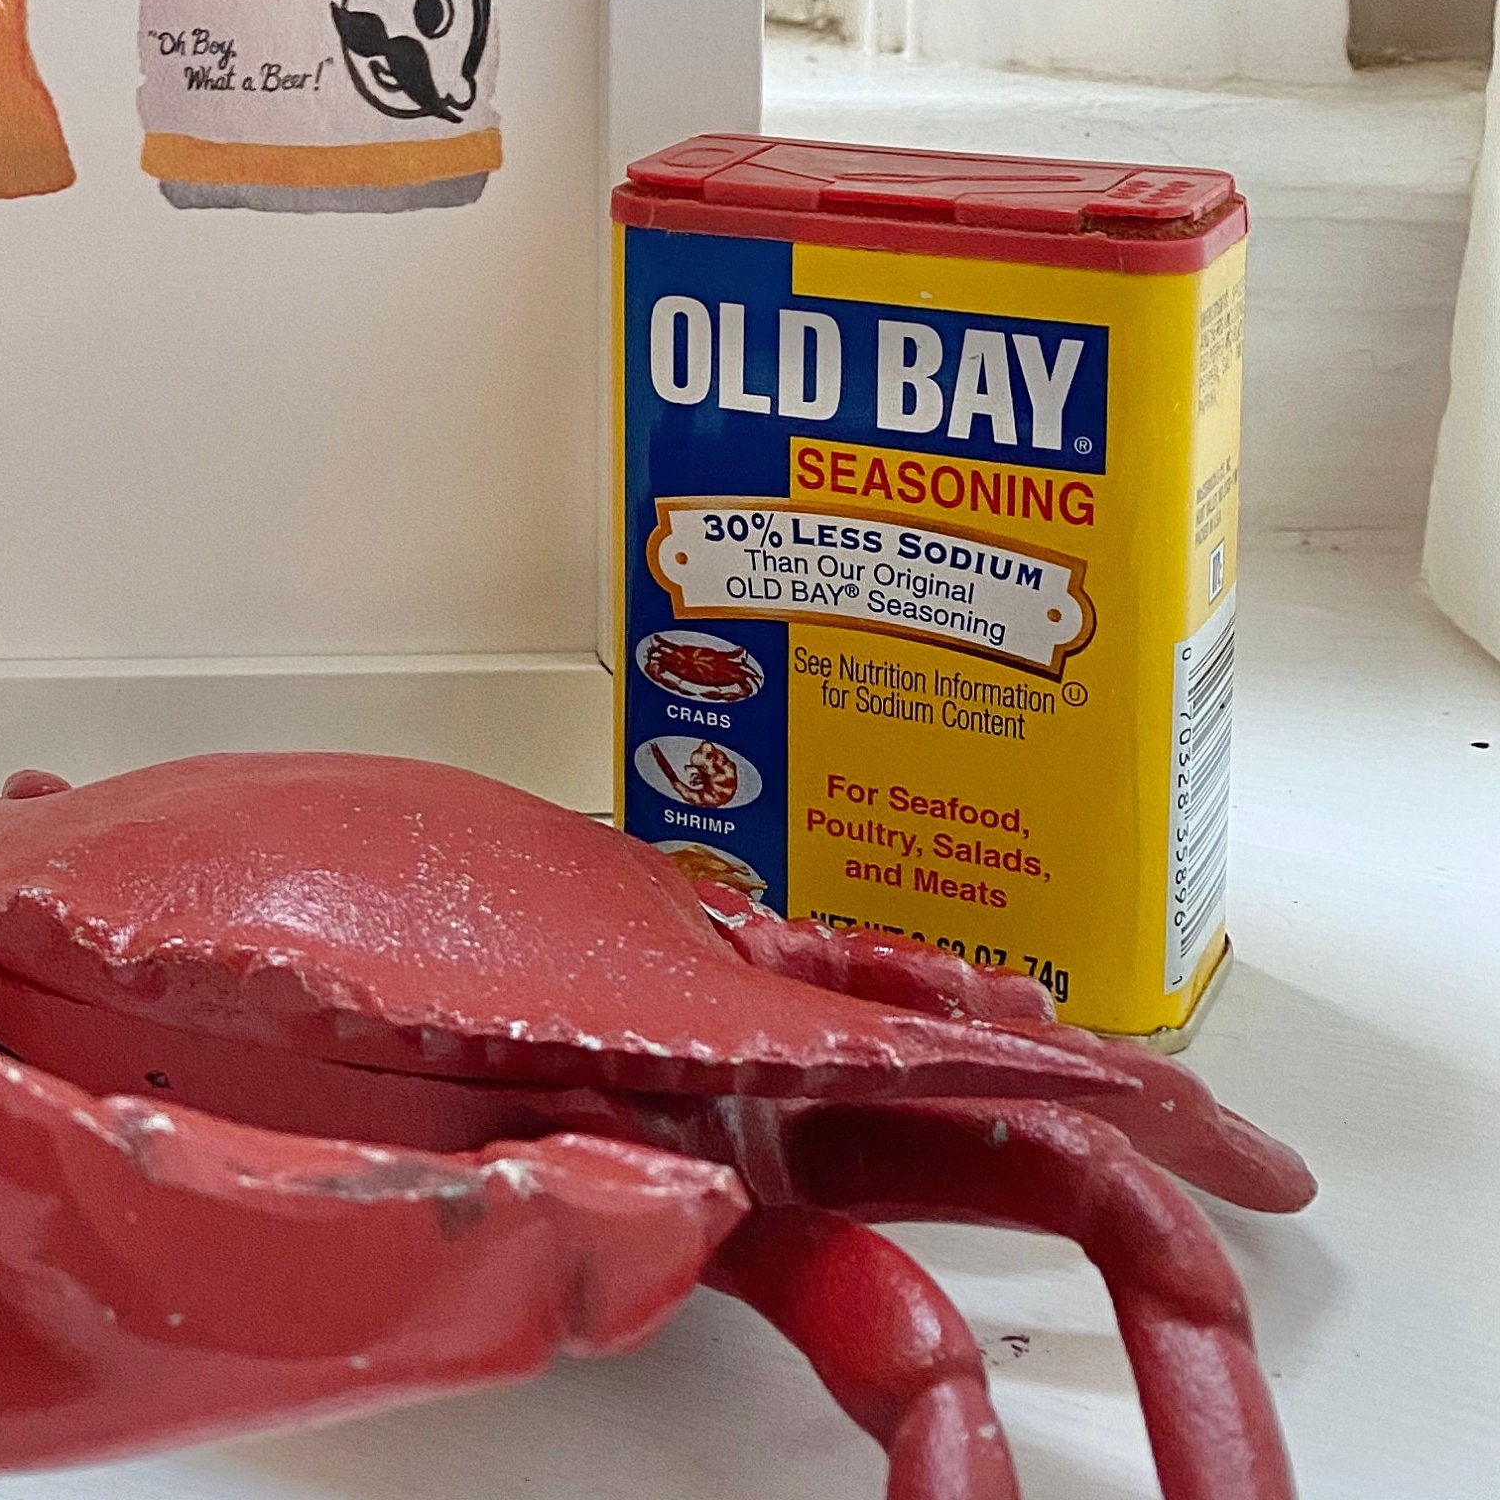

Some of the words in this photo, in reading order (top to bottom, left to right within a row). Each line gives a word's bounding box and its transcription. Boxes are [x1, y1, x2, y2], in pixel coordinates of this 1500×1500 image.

[185, 66, 235, 91] What
[242, 75, 256, 91] a
[650, 295, 842, 422] OLD
[796, 446, 1096, 526] SEASONING
[702, 512, 783, 549] 30%
[744, 549, 809, 575] Than
[818, 555, 866, 582] Our
[873, 563, 975, 604] Original
[726, 576, 783, 601] OLD
[868, 590, 1007, 646] Seasoning
[794, 646, 833, 678] See
[839, 653, 927, 694] Nutrition
[934, 669, 1056, 715] Information
[821, 680, 851, 710] for
[855, 685, 934, 725] Sodium
[941, 701, 1026, 740] Content
[666, 704, 732, 729] CRABS
[664, 808, 736, 835] SHRIMP
[827, 774, 879, 806] For
[888, 785, 1030, 840] Seafood,
[806, 807, 923, 858] Poultry,
[932, 832, 1052, 884] Salads,
[844, 859, 903, 889] and
[913, 866, 1008, 909] Meats
